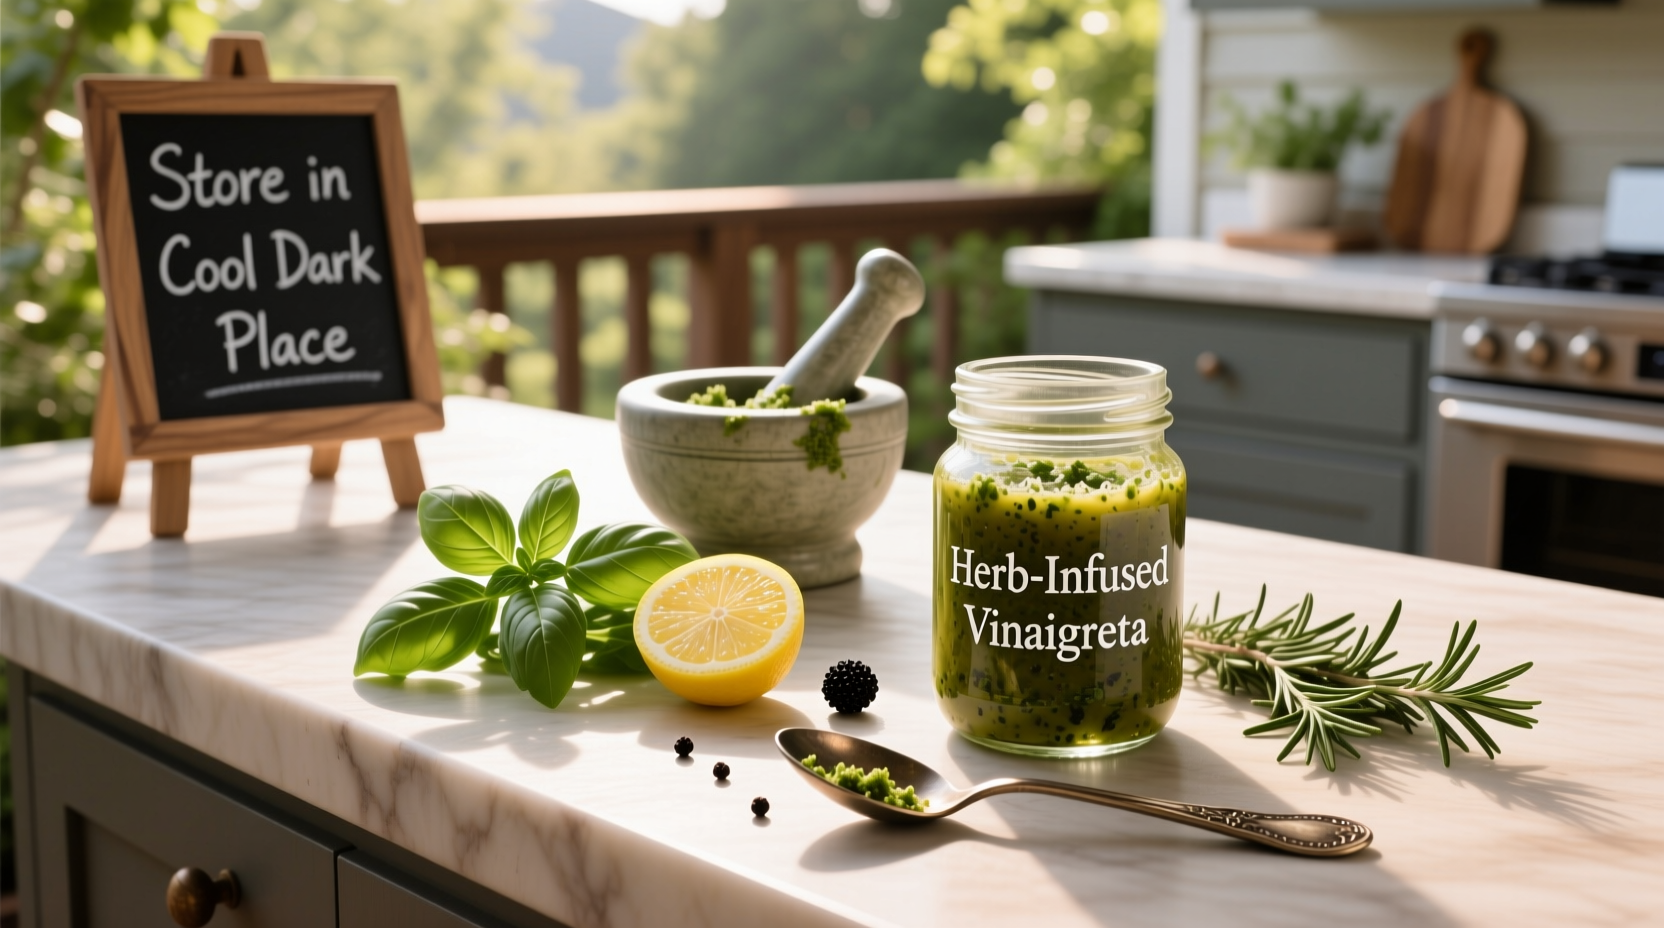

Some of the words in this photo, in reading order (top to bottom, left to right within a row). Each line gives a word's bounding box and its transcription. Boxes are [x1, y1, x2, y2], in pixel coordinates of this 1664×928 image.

[150, 142, 289, 211] Store
[307, 156, 351, 201] in
[159, 232, 257, 296] Cool
[270, 229, 382, 290] Dark
[215, 309, 356, 374] Place
[950, 545, 1169, 594] Herb-Infused
[963, 604, 1150, 662] Vinaigreta
